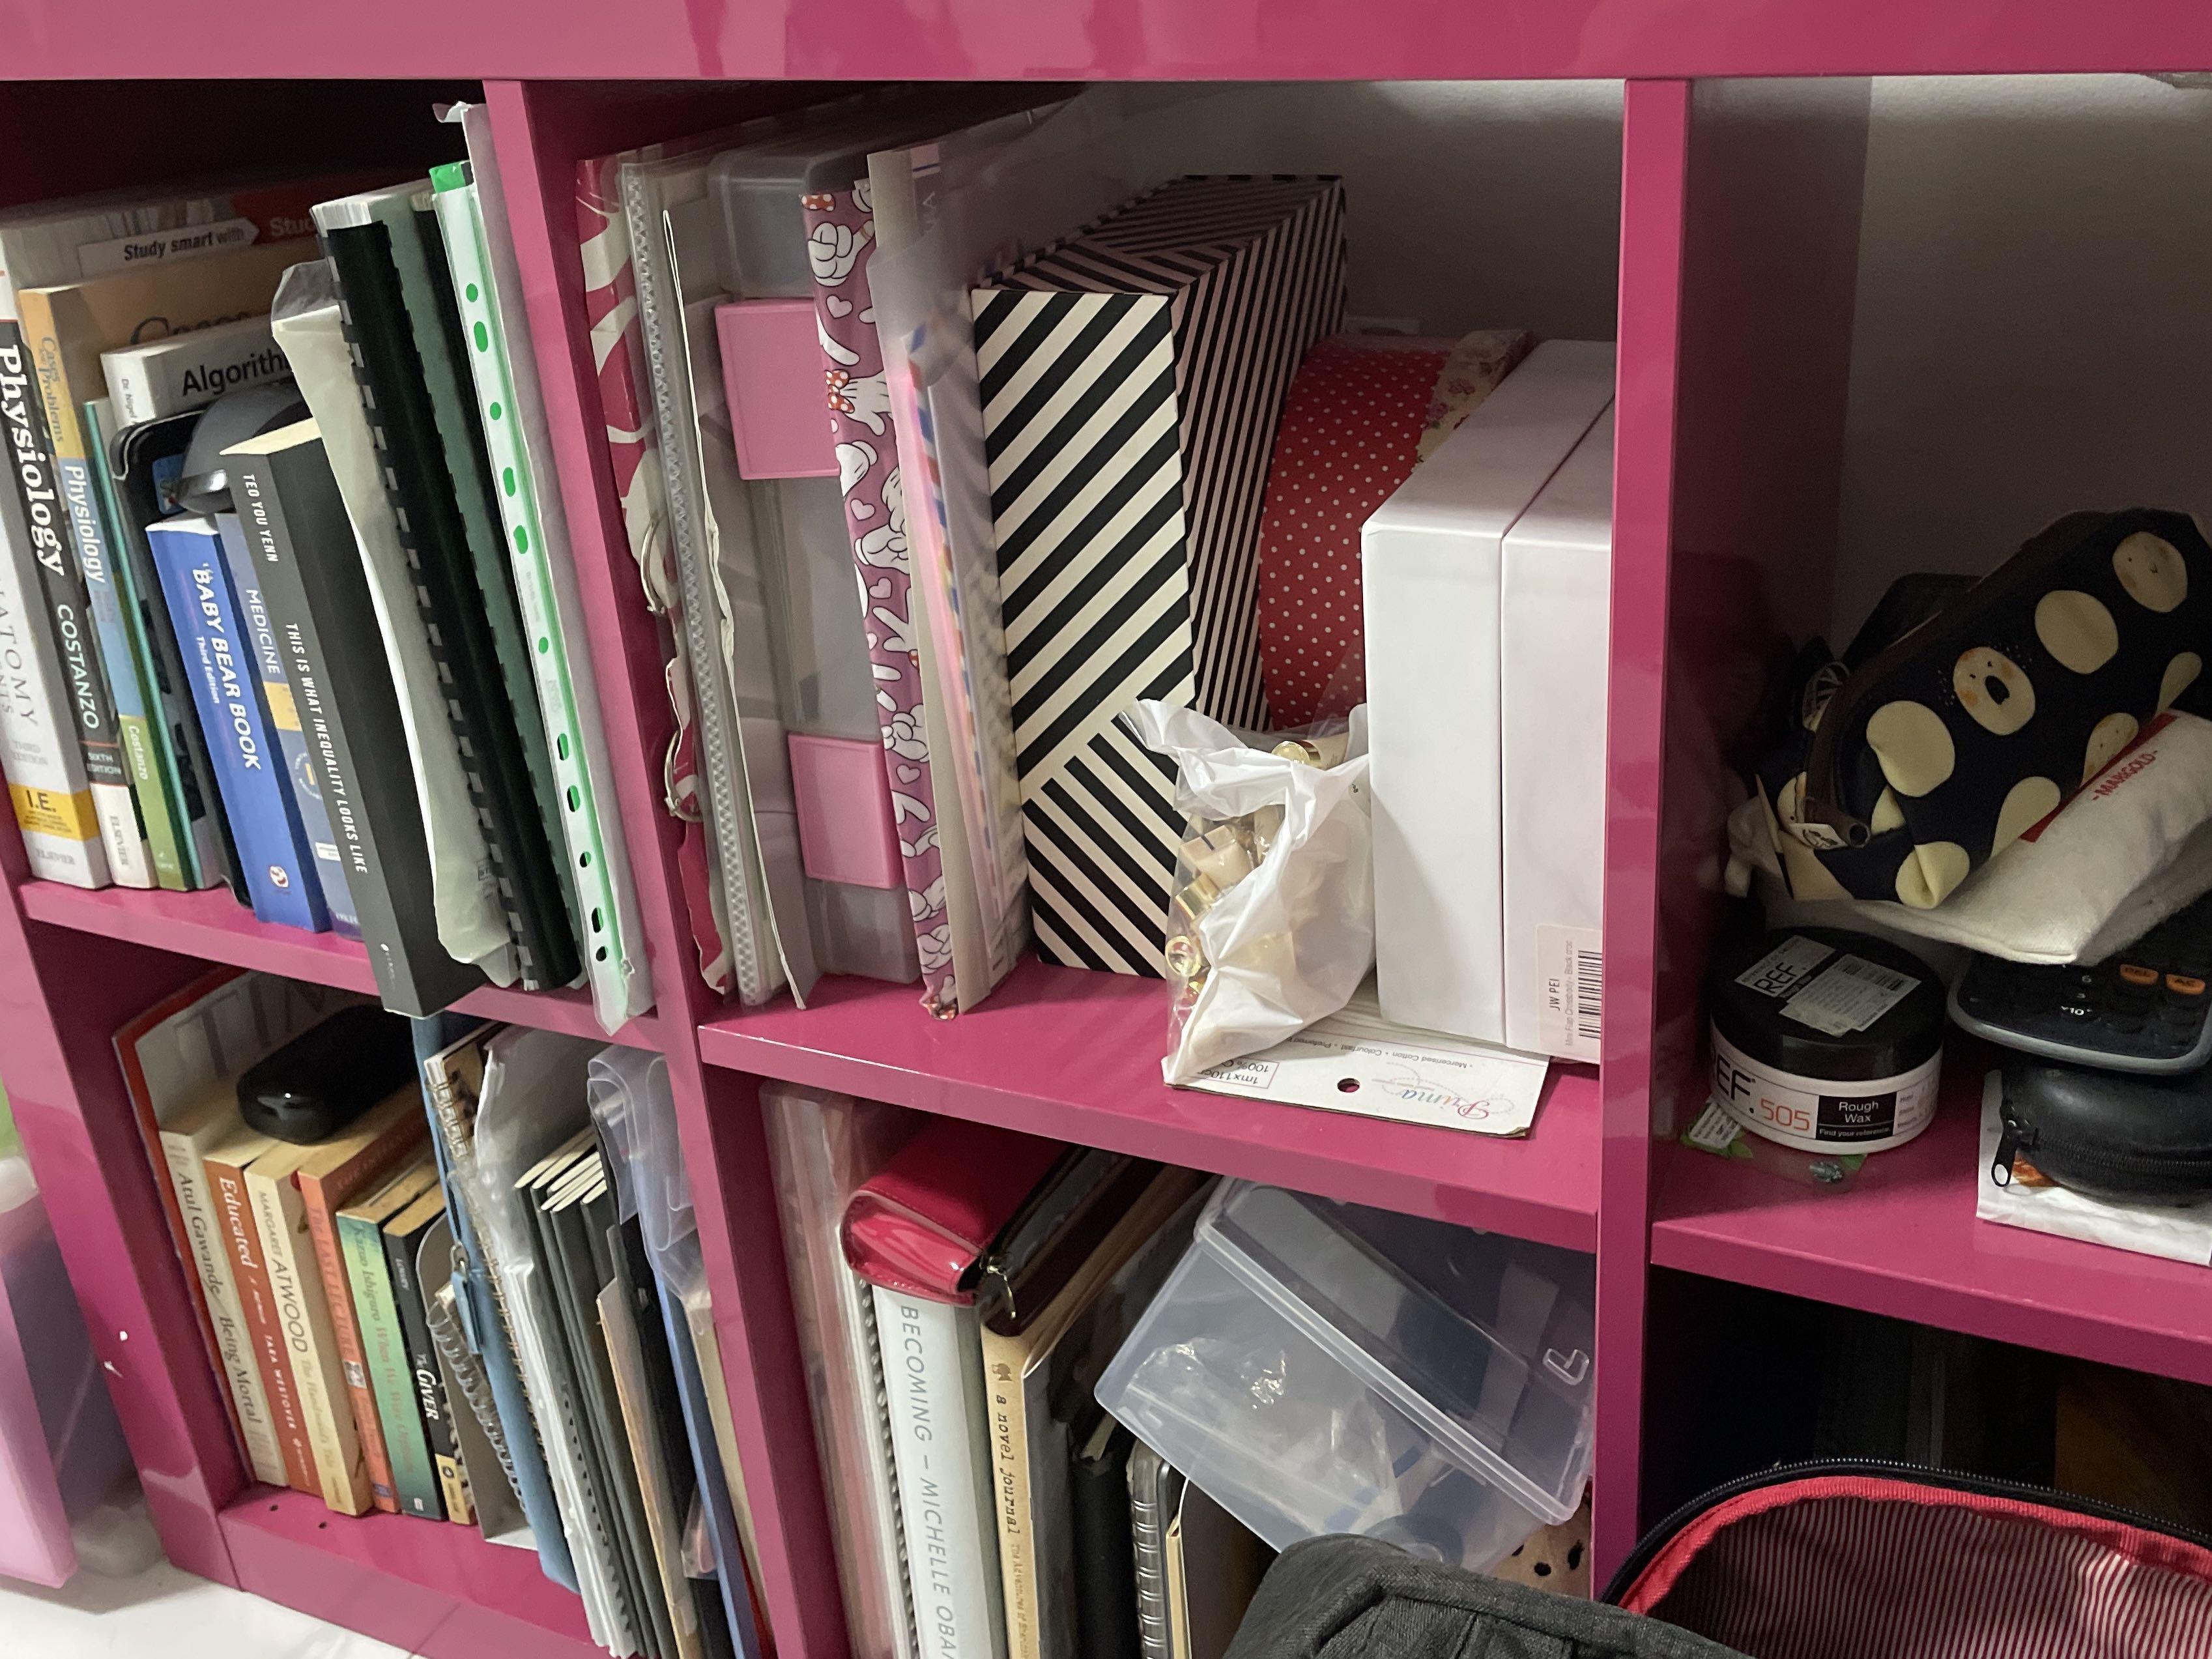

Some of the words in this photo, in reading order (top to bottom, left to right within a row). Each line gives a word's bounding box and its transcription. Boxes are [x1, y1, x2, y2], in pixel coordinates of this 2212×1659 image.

[124, 240, 165, 261] Study
[171, 232, 214, 253] smart
[216, 226, 246, 244] with
[243, 474, 261, 498] TEO
[65, 465, 106, 584] Physiology
[251, 501, 268, 526] YOU
[0, 344, 65, 576] Physiology
[57, 603, 100, 729] COSTANZO
[259, 529, 279, 562] YENN
[246, 589, 281, 674] MEDICINE
[285, 622, 305, 656] THIS
[195, 635, 212, 665] Third
[204, 666, 220, 704] Edition
[296, 658, 310, 673] IS
[211, 637, 241, 698] BEAR
[229, 702, 261, 771] BOOK
[300, 677, 323, 715] WHAT
[128, 725, 149, 780] Costanzo
[313, 718, 347, 796] INEQUALITY
[26, 789, 57, 813] I.E.
[336, 799, 359, 842] LOOKS
[349, 844, 368, 874] LIKE
[1548, 977, 1560, 994] PEI
[1549, 996, 1560, 1011] JW
[1237, 1060, 1269, 1073] 100%
[1341, 1044, 1383, 1056] Colourfast
[1392, 1052, 1420, 1062] Cotton
[1760, 1097, 1811, 1132] 505
[1838, 1100, 1880, 1113] Rough
[1844, 1113, 1872, 1123] Wax
[1818, 1128, 1837, 1136] Find
[219, 1176, 259, 1269] Educated
[179, 1172, 202, 1213] Atul
[192, 1215, 223, 1296] Gawande
[218, 1315, 241, 1364] Being
[233, 1365, 263, 1424] Mortal
[271, 1256, 308, 1353] ATWOOD
[996, 1394, 1007, 1406] a
[997, 1411, 1014, 1461] novel
[900, 1305, 932, 1442] BECOMING
[919, 1477, 951, 1596] MICHELLE
[936, 1605, 958, 1659] OBA
[999, 1467, 1021, 1535] journal
